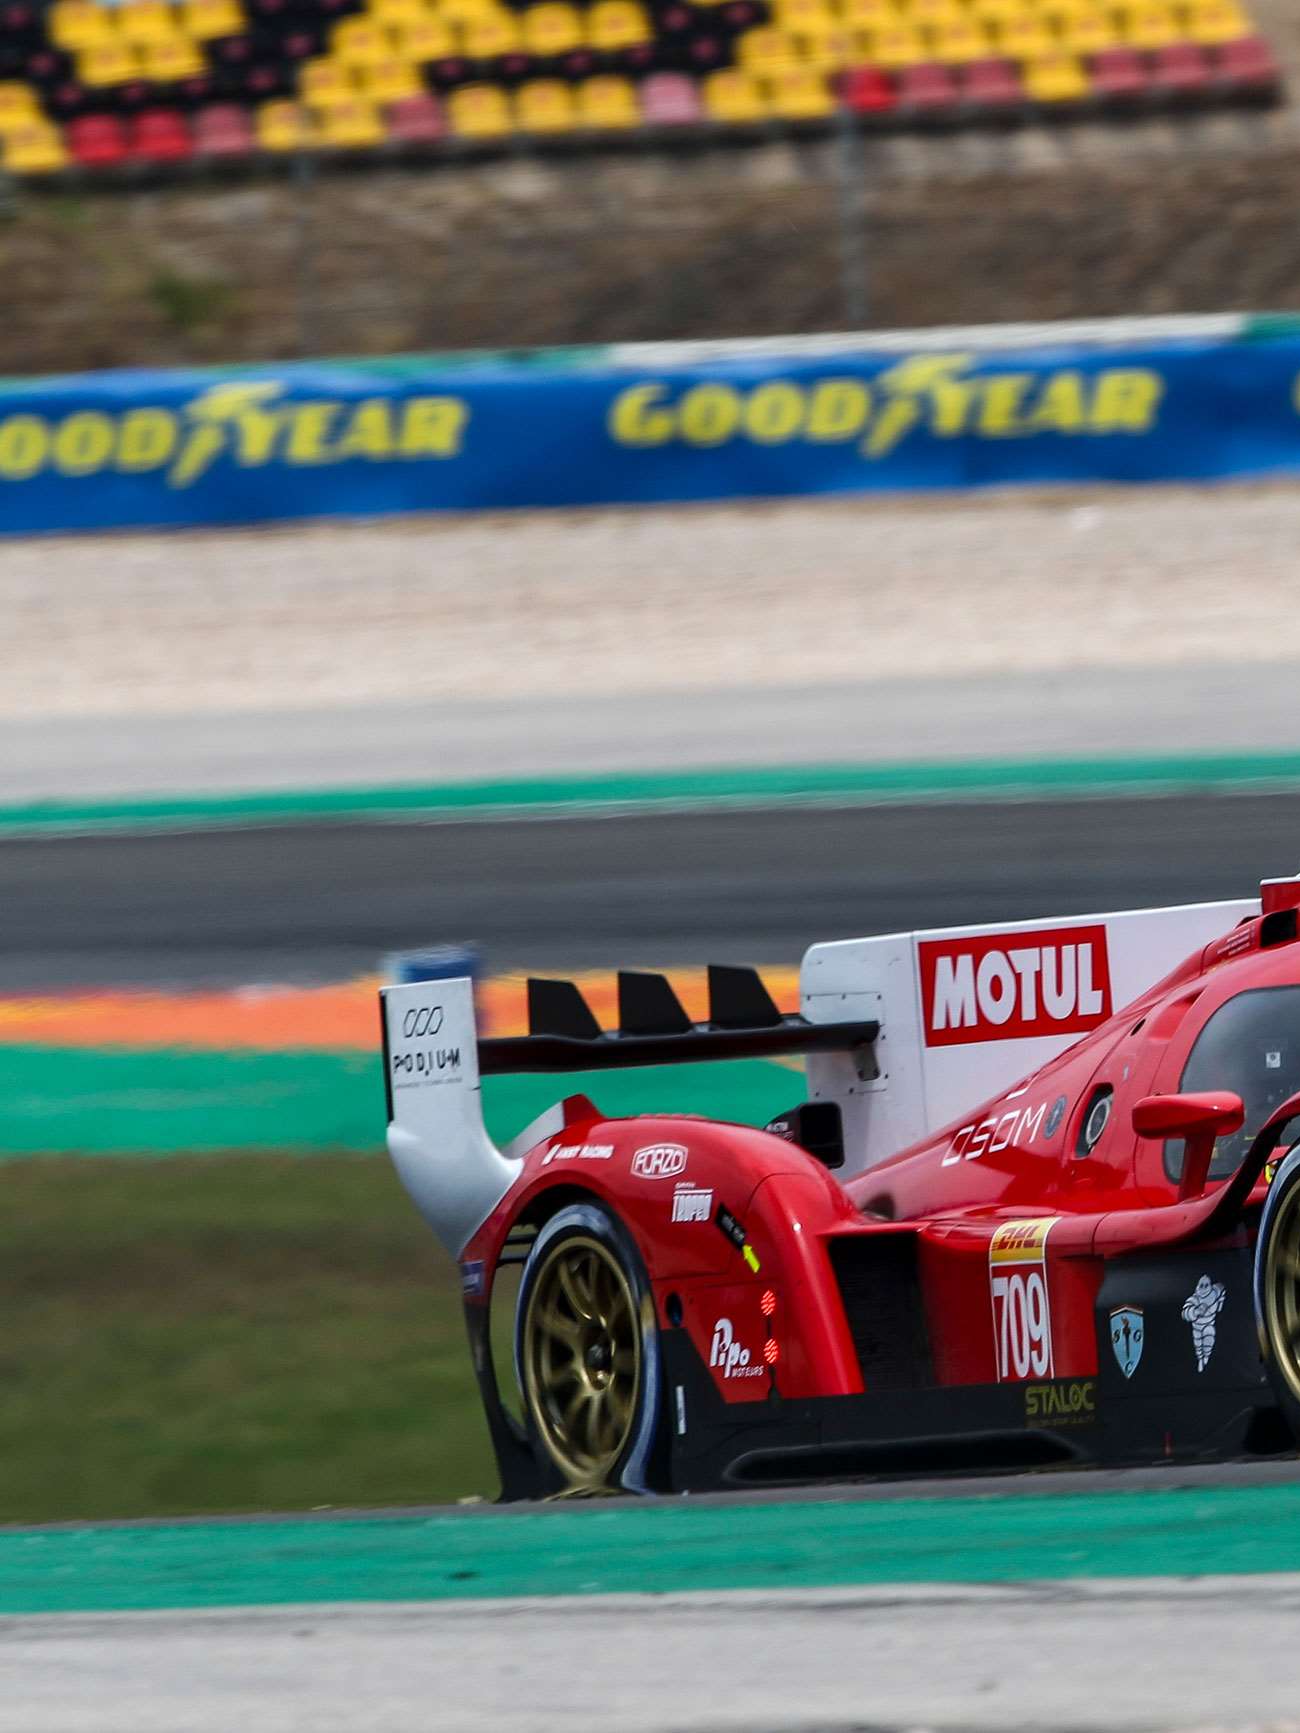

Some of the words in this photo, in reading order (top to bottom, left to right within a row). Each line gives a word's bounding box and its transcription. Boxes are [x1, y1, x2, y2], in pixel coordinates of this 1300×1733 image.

[0, 380, 466, 488] OODYEAR
[609, 352, 1162, 459] GOODYEAR
[931, 943, 1103, 1030] MOTUL
[393, 1048, 461, 1076] PODIUM
[709, 1318, 750, 1378] Pipo
[992, 1272, 1049, 1378] 709
[1025, 1382, 1096, 1416] STALOC
